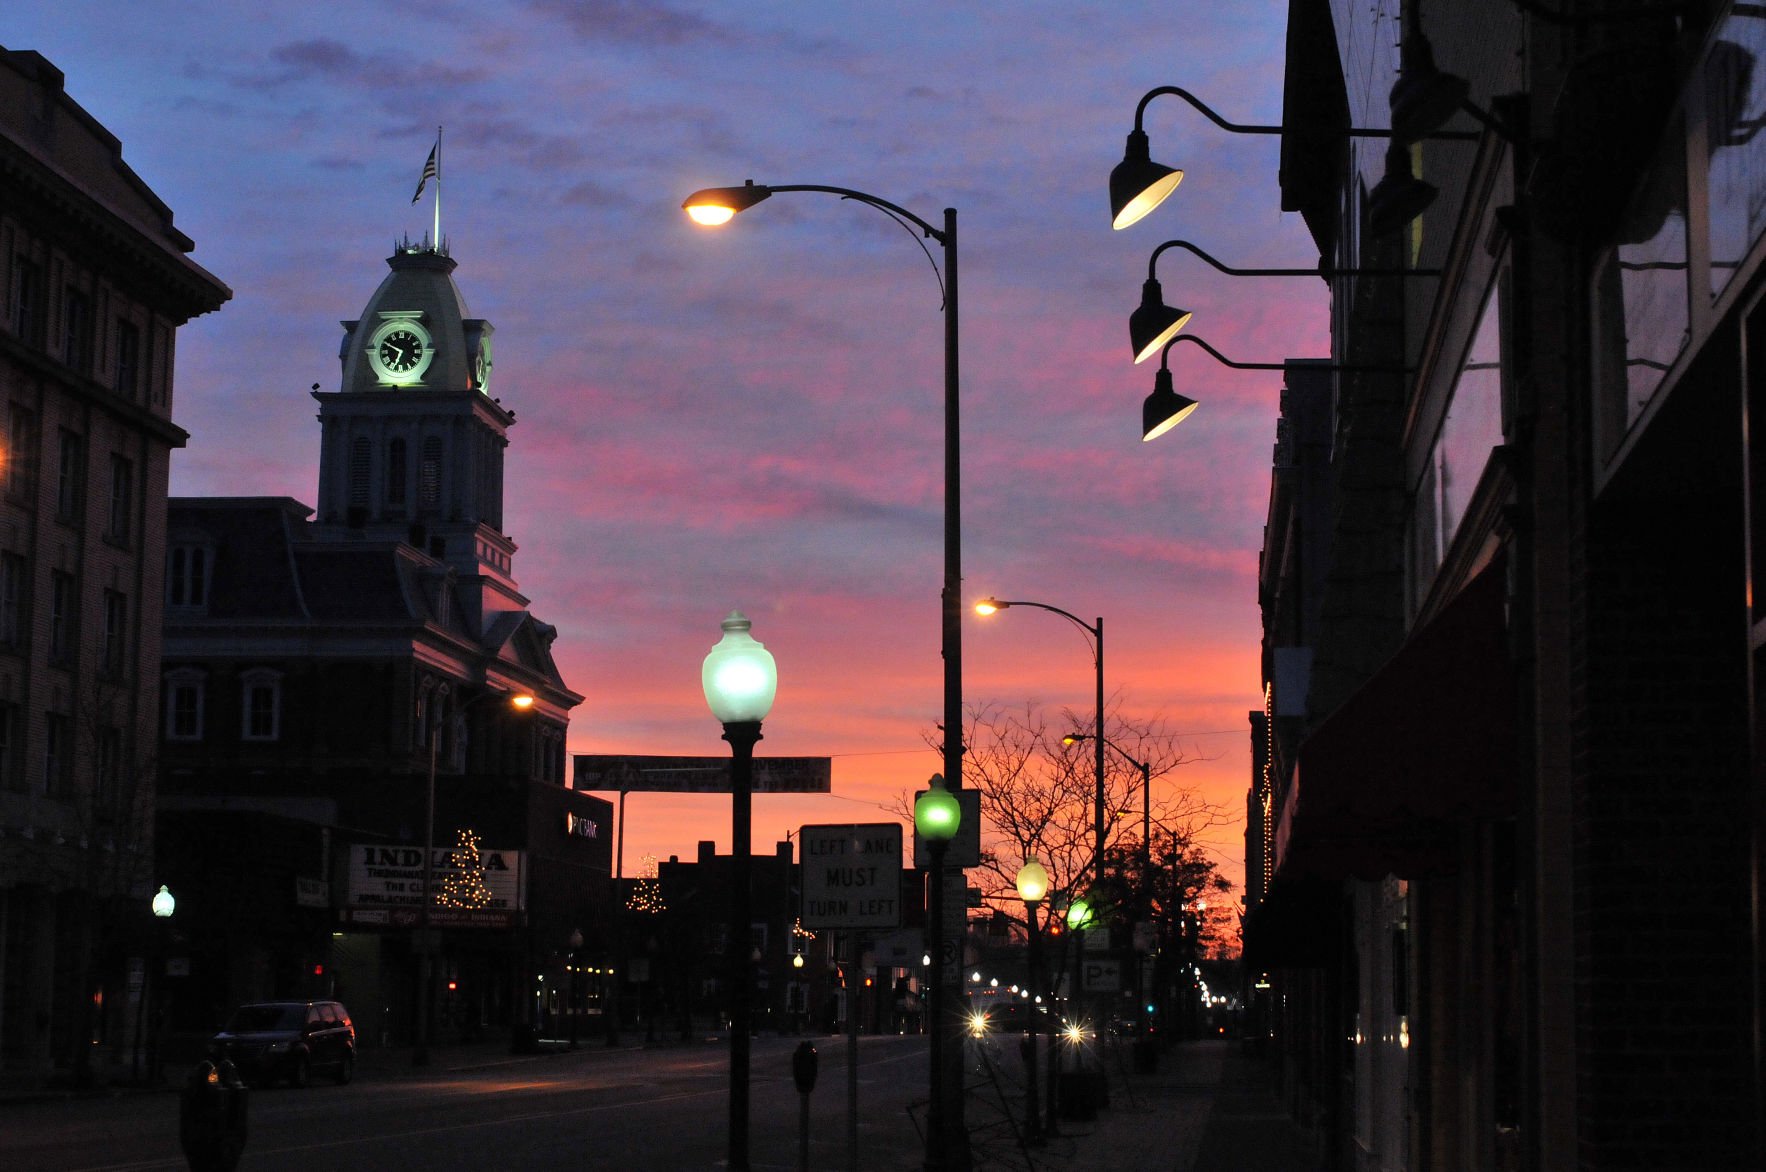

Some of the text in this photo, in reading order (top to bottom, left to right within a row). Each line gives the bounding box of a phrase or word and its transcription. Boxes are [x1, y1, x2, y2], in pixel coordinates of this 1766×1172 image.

[809, 839, 846, 855] LEFT
[364, 847, 509, 871] INDAA
[827, 867, 876, 887] MUST
[385, 881, 405, 892] THE
[808, 899, 895, 916] TURN LEFT
